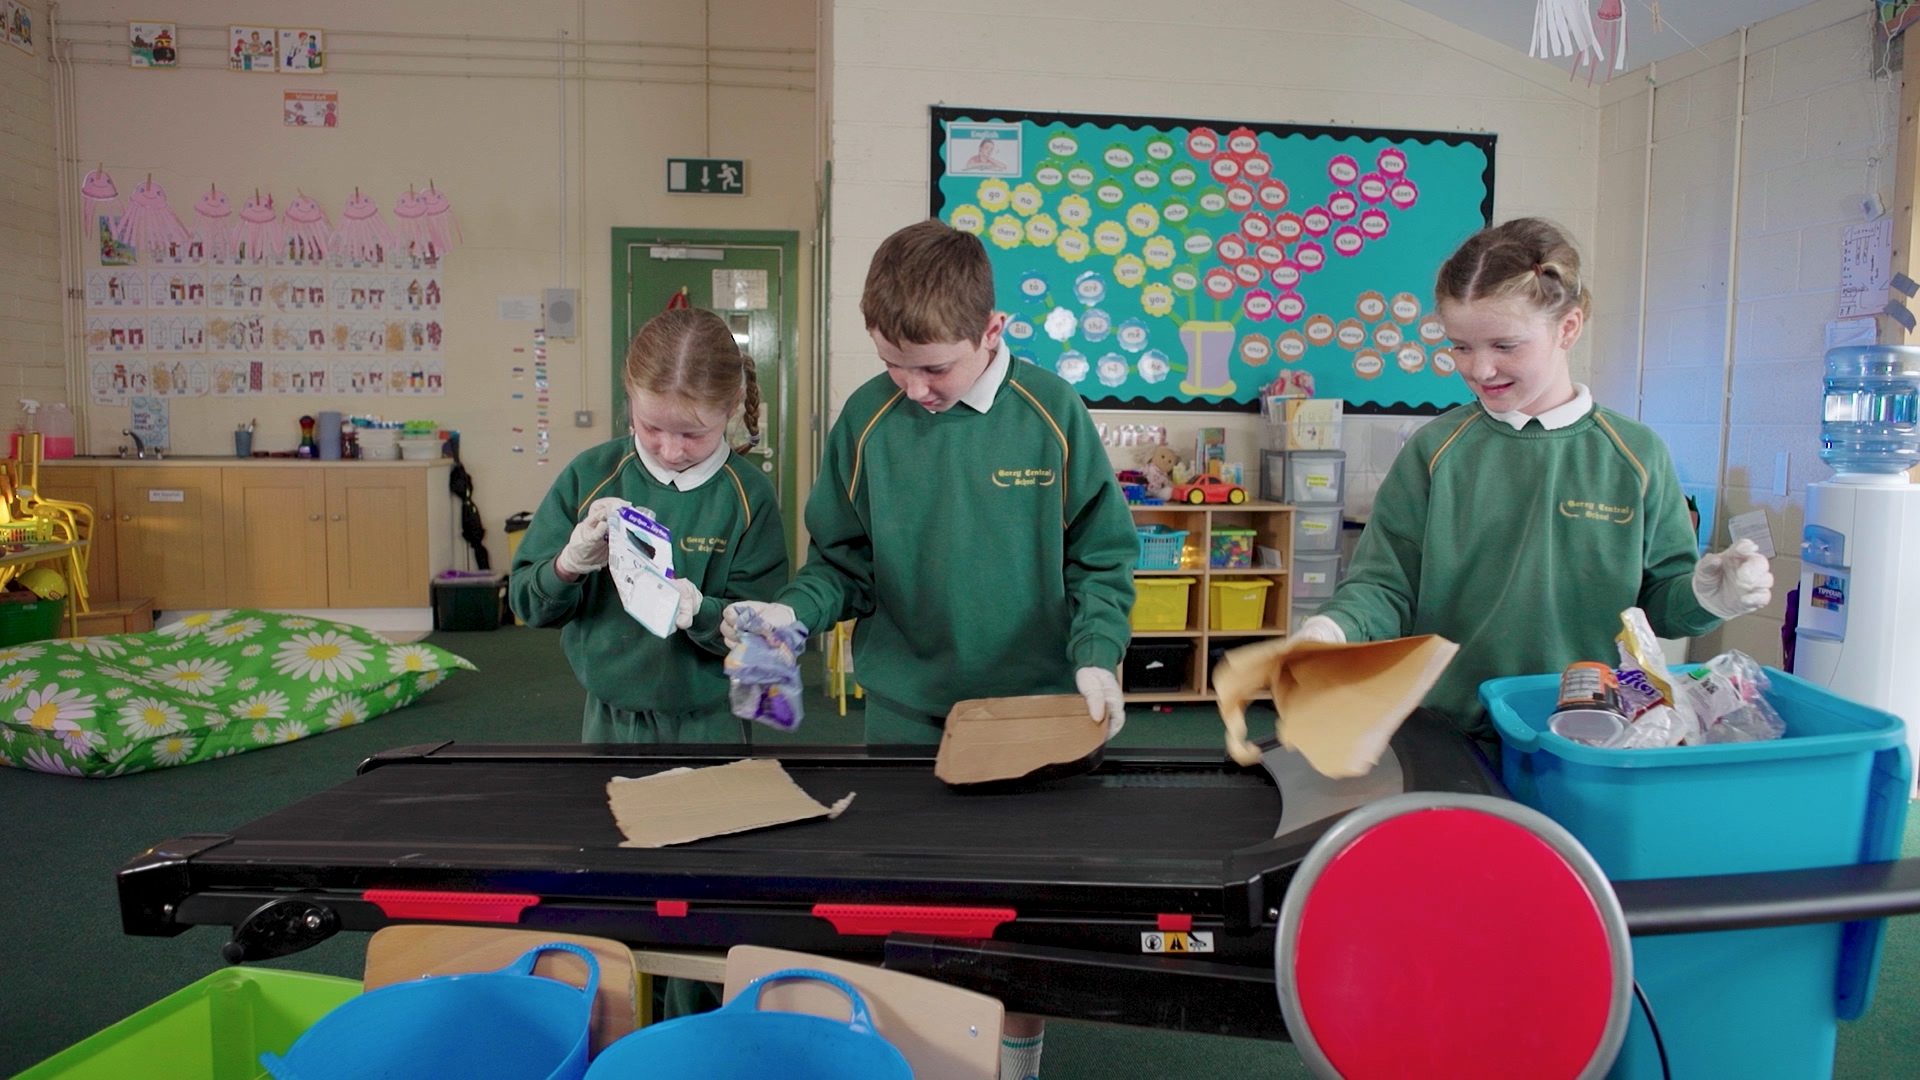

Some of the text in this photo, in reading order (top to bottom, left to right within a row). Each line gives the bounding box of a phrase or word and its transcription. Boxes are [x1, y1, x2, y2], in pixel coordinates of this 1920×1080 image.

[971, 130, 999, 140] English
[1052, 142, 1074, 152] before
[1152, 148, 1168, 156] why
[1108, 155, 1129, 163] which
[1249, 164, 1265, 172] only
[1336, 167, 1350, 176] four
[1070, 173, 1091, 181] where
[988, 191, 1000, 200] go
[1265, 192, 1280, 200] give
[1020, 197, 1032, 205] no
[959, 218, 977, 227] they
[1136, 218, 1150, 228] my
[1309, 218, 1326, 226] right
[1034, 225, 1050, 236] here
[1250, 222, 1262, 232] like
[1280, 224, 1297, 232] little
[997, 227, 1016, 237] there
[1065, 240, 1081, 250] said
[1121, 268, 1138, 276] your
[1083, 284, 1098, 292] are
[1149, 296, 1166, 305] you
[1284, 303, 1296, 311] put
[1015, 326, 1027, 334] all
[1025, 468, 1052, 477] Central
[1014, 477, 1036, 486] School
[1598, 503, 1630, 514] Central
[1585, 511, 1609, 520] School
